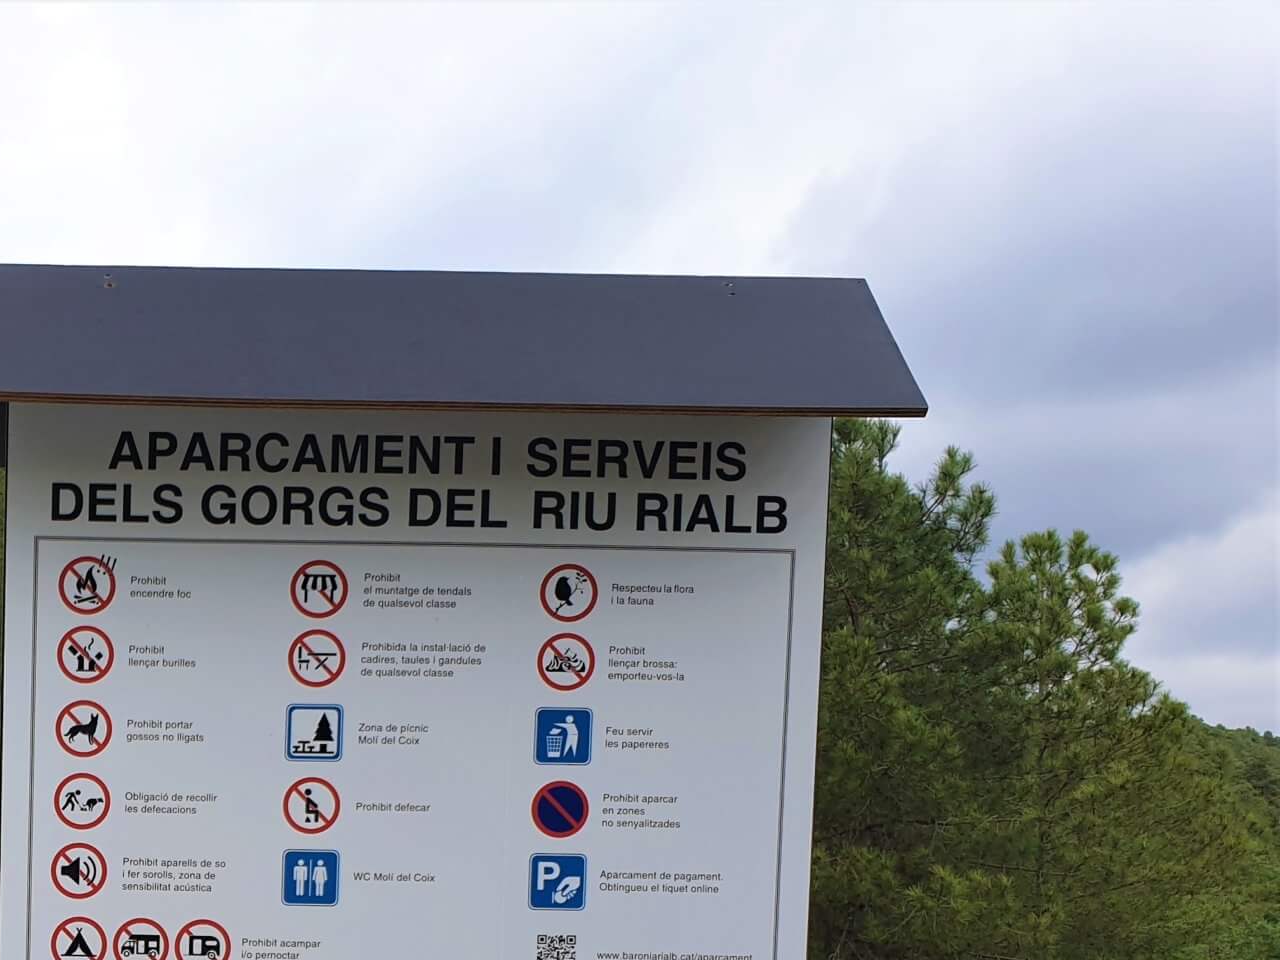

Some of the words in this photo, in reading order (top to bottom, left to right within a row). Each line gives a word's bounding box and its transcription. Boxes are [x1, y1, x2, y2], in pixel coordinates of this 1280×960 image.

[108, 430, 475, 475] APARCAMENT
[491, 436, 501, 476] I
[526, 436, 746, 482] SERVEIS
[51, 482, 183, 524] DELS
[200, 483, 389, 527] GORGS
[408, 487, 507, 528] DEL
[532, 489, 616, 531] RIU
[635, 492, 787, 534] RIALB
[130, 575, 166, 585] Prohibit
[364, 572, 400, 582] Prohibit
[129, 588, 174, 599] encendre
[176, 588, 191, 599] foc
[363, 584, 372, 595] el
[374, 585, 419, 597] muntatge
[422, 585, 434, 596] de
[437, 585, 471, 596] tendals
[611, 582, 662, 594] Respecteu
[663, 583, 672, 594] la
[673, 583, 694, 594] flora
[362, 597, 375, 607] de
[377, 598, 423, 609] qualsevol
[425, 598, 456, 609] classe
[610, 595, 614, 605] i
[616, 595, 624, 605] la
[627, 595, 654, 606] fauna
[128, 644, 164, 655] Prohibit
[361, 641, 406, 652] Prohibida
[409, 642, 417, 652] la
[473, 643, 486, 653] de
[609, 645, 645, 656] Prohibit
[128, 657, 159, 669] llençar
[161, 657, 196, 668] burilles
[360, 654, 398, 667] cadires,
[401, 655, 430, 665] taules
[432, 654, 436, 664] i
[438, 655, 481, 667] gandules
[608, 657, 640, 670] llençar
[360, 667, 373, 677] de
[375, 666, 420, 678] qualsevol
[422, 667, 454, 678] classe
[607, 671, 684, 682] emporteu-vos-la
[126, 718, 162, 729] Prohibit
[165, 720, 192, 731] portar
[358, 722, 383, 733] Zona
[385, 722, 398, 733] de
[605, 725, 624, 736] Feu
[626, 727, 653, 736] servir
[126, 732, 159, 743] gossos
[162, 733, 174, 742] no
[176, 732, 204, 744] lligats
[358, 734, 378, 745] Molí
[380, 735, 395, 745] del
[398, 735, 419, 745] Coix
[604, 738, 618, 748] les
[621, 740, 669, 751] papereres
[124, 790, 168, 803] Obligació
[170, 792, 183, 802] de
[185, 792, 217, 802] recollir
[602, 792, 639, 803] Prohibit
[641, 795, 677, 805] aparcar
[124, 804, 138, 814] les
[140, 804, 196, 815] defecacions
[355, 801, 391, 812] Prohibit
[394, 802, 430, 812] defecar
[601, 807, 614, 815] en
[616, 807, 645, 816] zones
[601, 819, 614, 828] no
[616, 818, 680, 830] senyalitzades
[122, 856, 158, 867] Prohibit
[160, 858, 197, 869] aparells
[199, 858, 212, 868] de
[214, 860, 226, 868] so
[121, 870, 125, 879] i
[127, 869, 140, 879] fer
[142, 869, 175, 882] sorolls,
[178, 871, 201, 880] zona
[203, 870, 216, 880] de
[353, 871, 370, 882] WC
[373, 872, 393, 882] Molí
[396, 872, 411, 882] del
[413, 872, 435, 882] Coix
[537, 861, 560, 890] P
[599, 869, 656, 881] Aparcament
[659, 871, 671, 880] de
[673, 872, 723, 883] pagament.
[121, 881, 170, 891] sensibilitat
[173, 882, 212, 893] acústica
[599, 881, 648, 894] Obtingueu
[650, 883, 659, 892] el
[662, 883, 688, 894] tiquet
[690, 883, 719, 893] online
[241, 937, 277, 947] Prohibit
[279, 940, 320, 950] acampar
[241, 949, 253, 959] i/o
[255, 951, 299, 960] pernoctar
